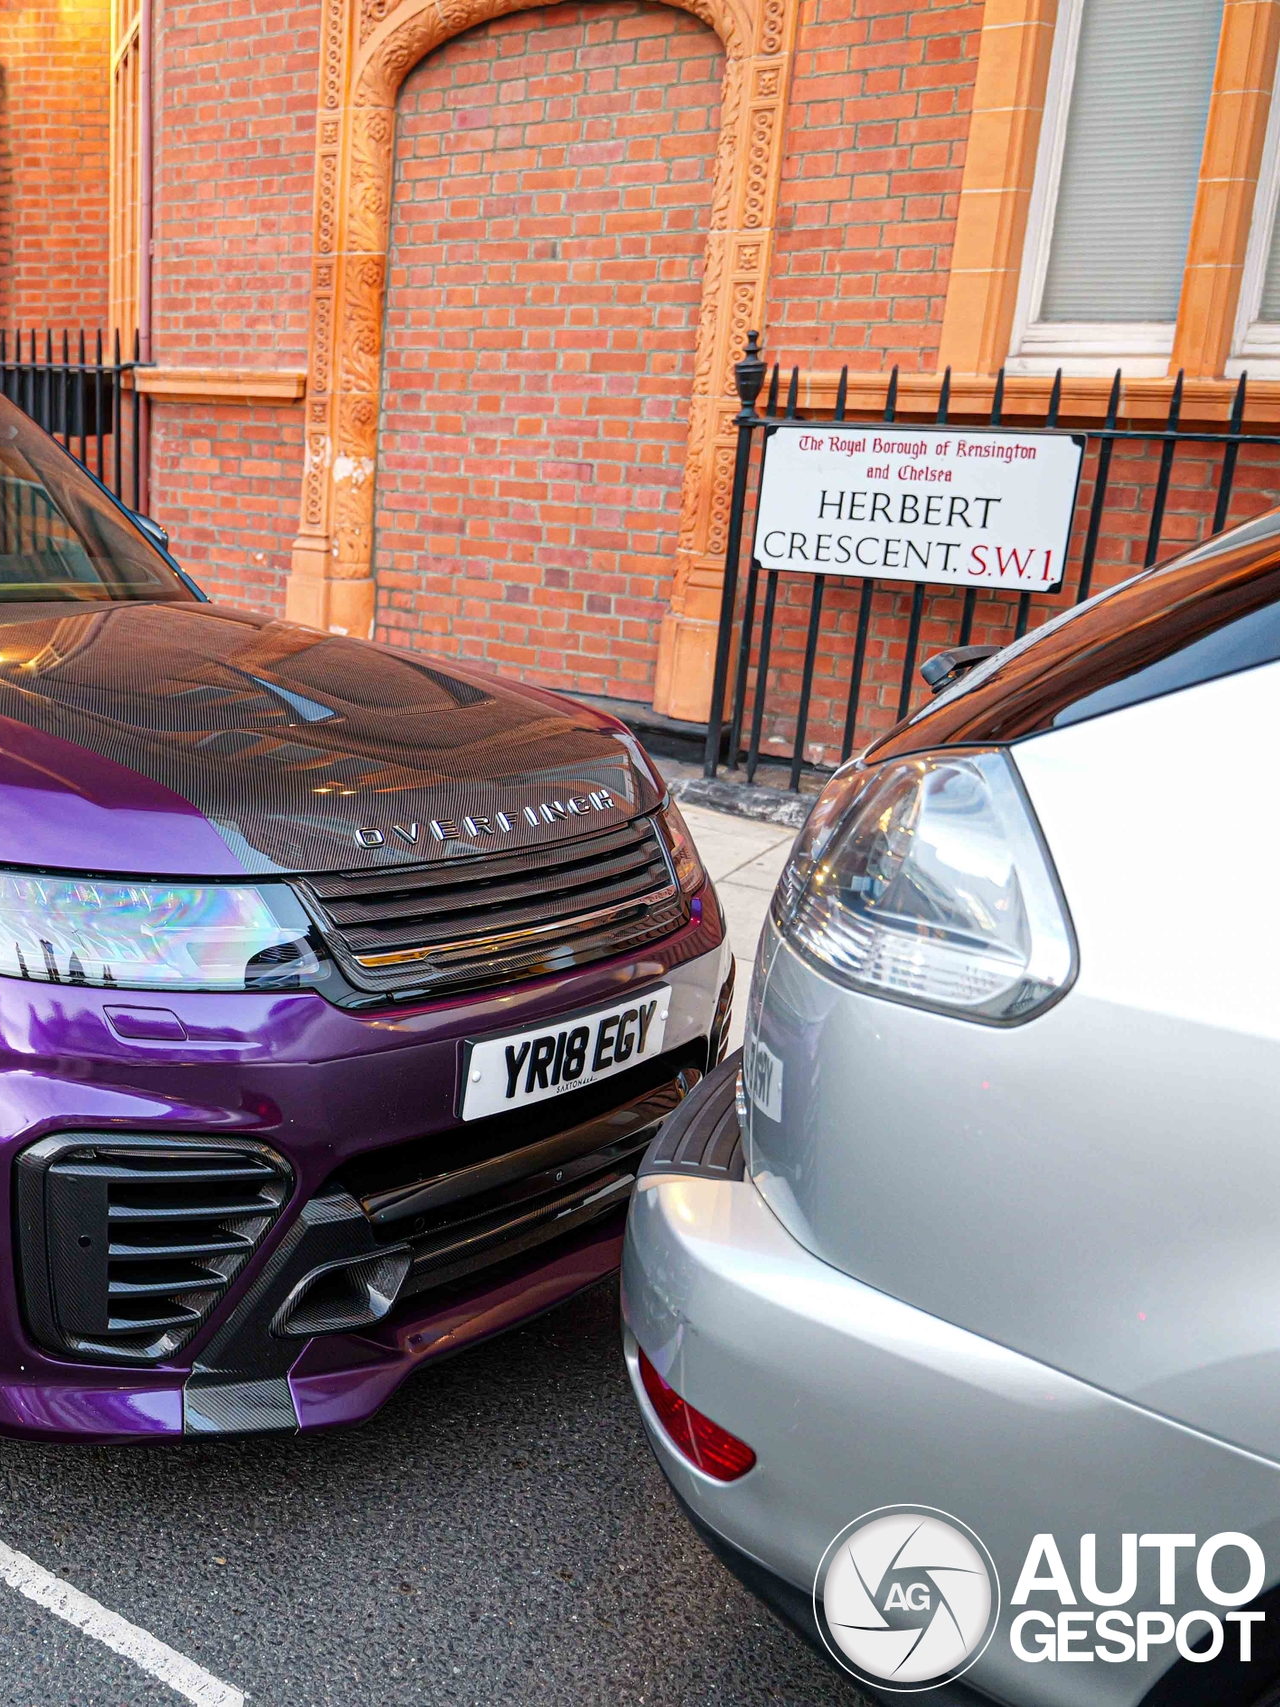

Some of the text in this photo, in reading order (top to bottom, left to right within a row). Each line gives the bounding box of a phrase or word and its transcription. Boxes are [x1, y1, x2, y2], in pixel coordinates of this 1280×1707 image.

[798, 435, 1037, 464] The Royal Borough of Kensington
[867, 464, 952, 482] and Chelsea
[817, 490, 1001, 528] HERBERT
[353, 789, 615, 849] OVERFINCH
[505, 1000, 657, 1099] YR18 EGY
